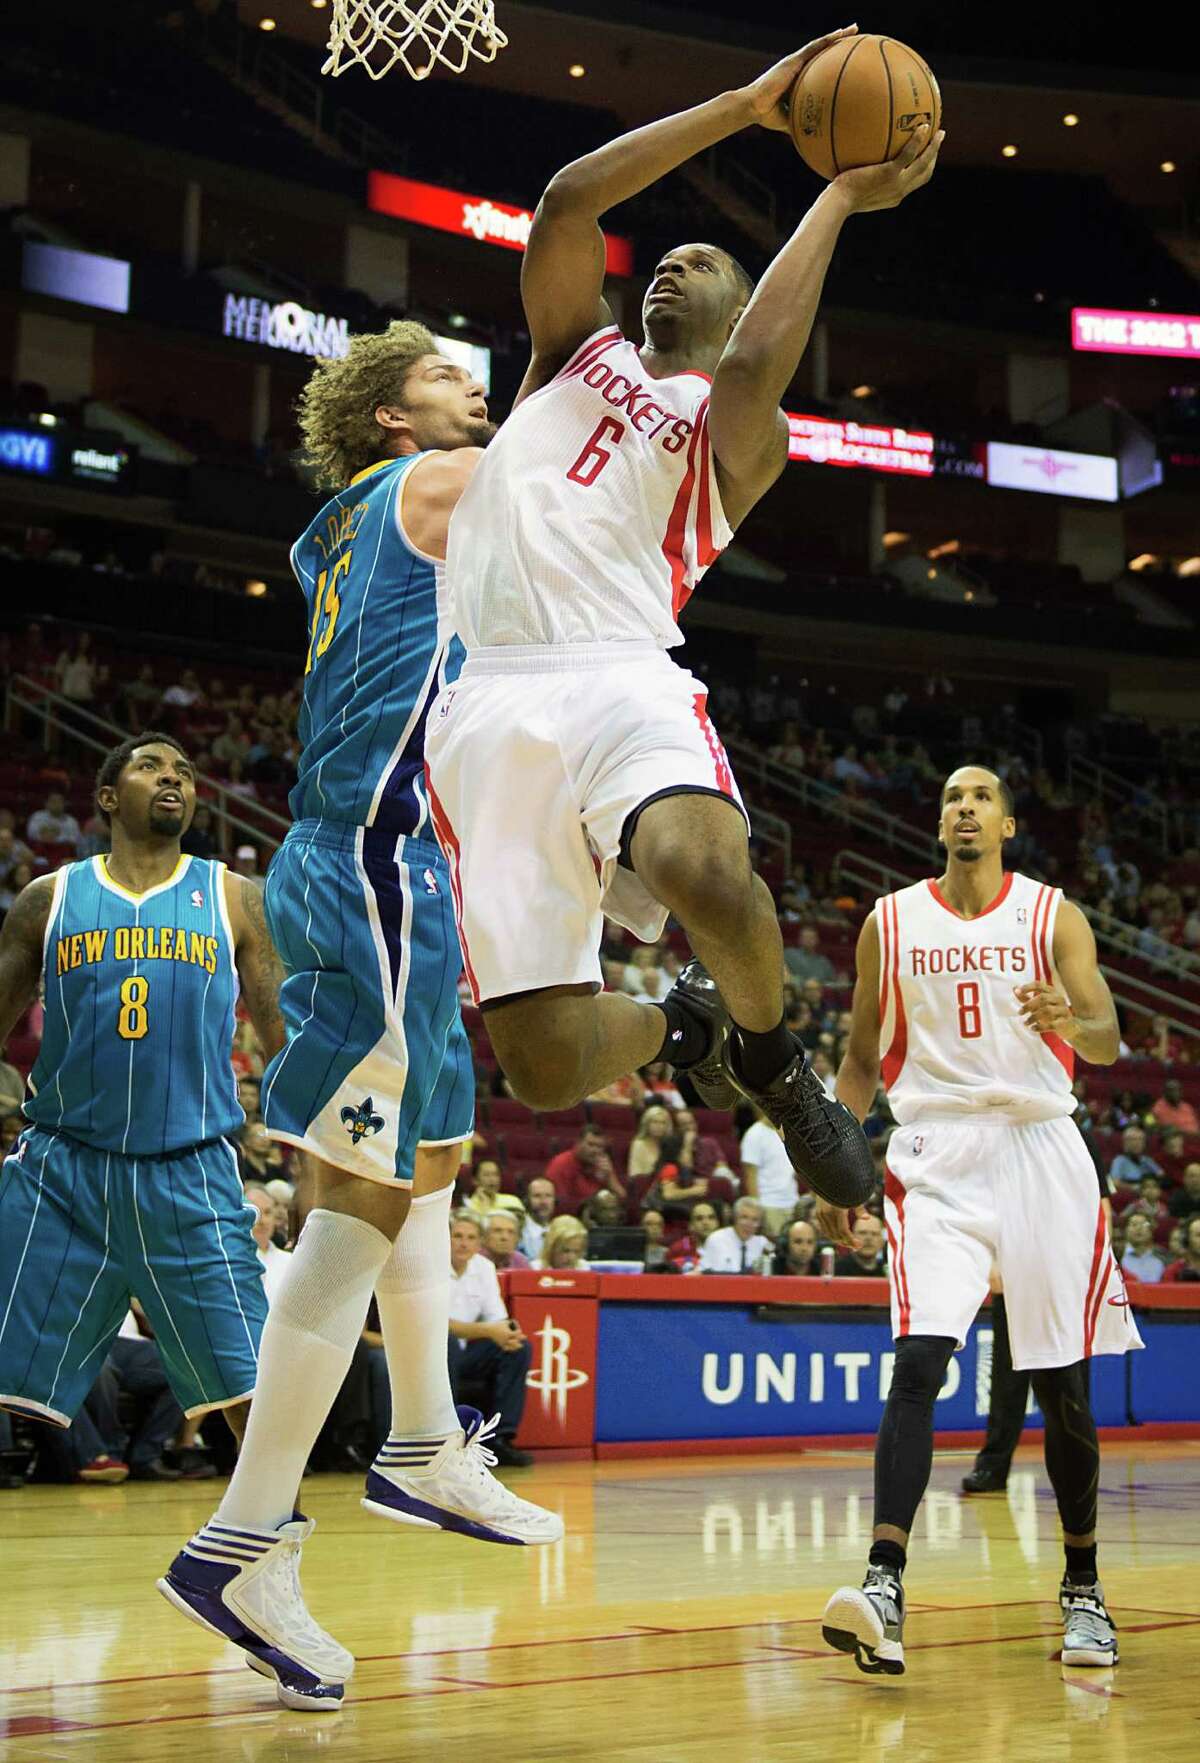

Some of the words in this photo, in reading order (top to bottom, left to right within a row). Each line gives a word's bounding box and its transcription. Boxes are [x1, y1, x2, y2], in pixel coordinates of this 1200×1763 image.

[462, 200, 533, 247] xfinit
[224, 292, 349, 342] MEMORIAL
[1077, 315, 1128, 345] THE
[1129, 319, 1186, 350] 2012
[583, 362, 694, 454] OCKETS
[72, 449, 119, 473] reliant
[566, 415, 626, 487] 6
[304, 550, 352, 676] 15
[56, 929, 109, 976] NEW
[114, 926, 219, 976] ORLEANS
[908, 945, 1027, 977] ROCKETS
[117, 975, 150, 1040] 8
[956, 981, 983, 1039] 8
